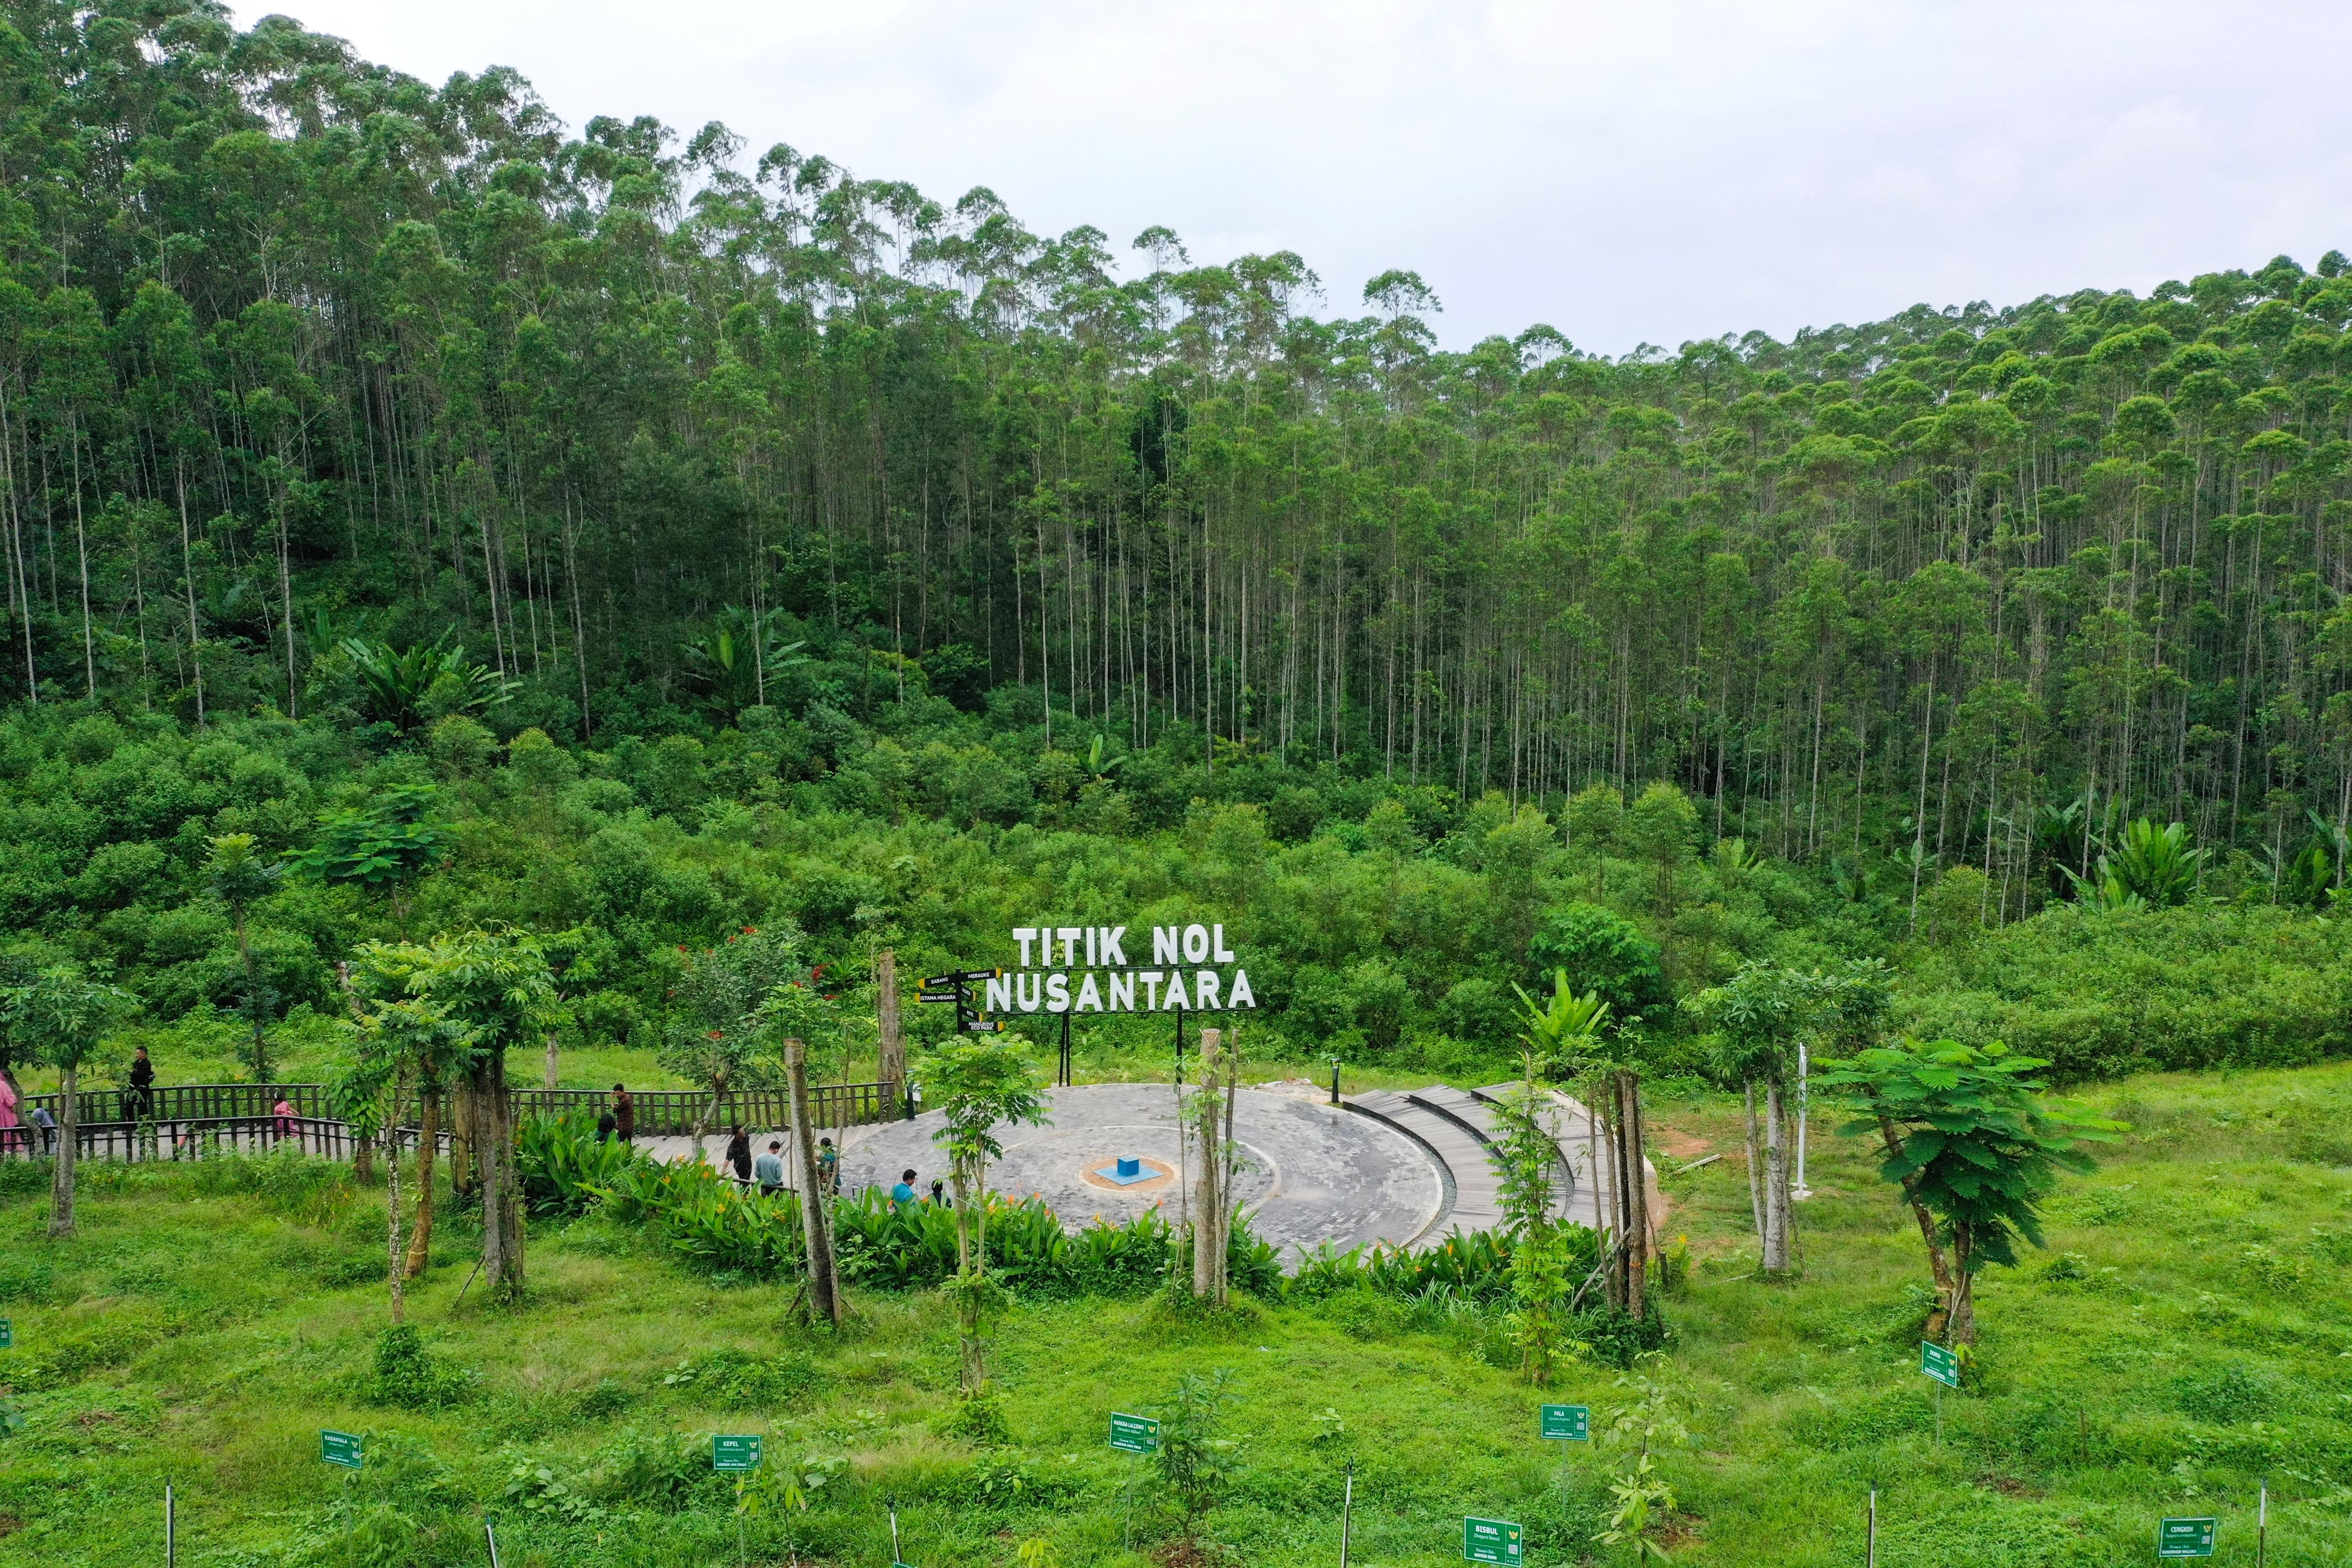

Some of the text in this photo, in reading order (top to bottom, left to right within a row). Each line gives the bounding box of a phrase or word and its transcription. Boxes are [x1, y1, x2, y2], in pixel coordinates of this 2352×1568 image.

[1013, 924, 1234, 966] TITIK NOL
[986, 970, 1256, 1012] NUSANTARA
[325, 1435, 348, 1444] RASAMALA
[1476, 1525, 1498, 1535] BISBUL
